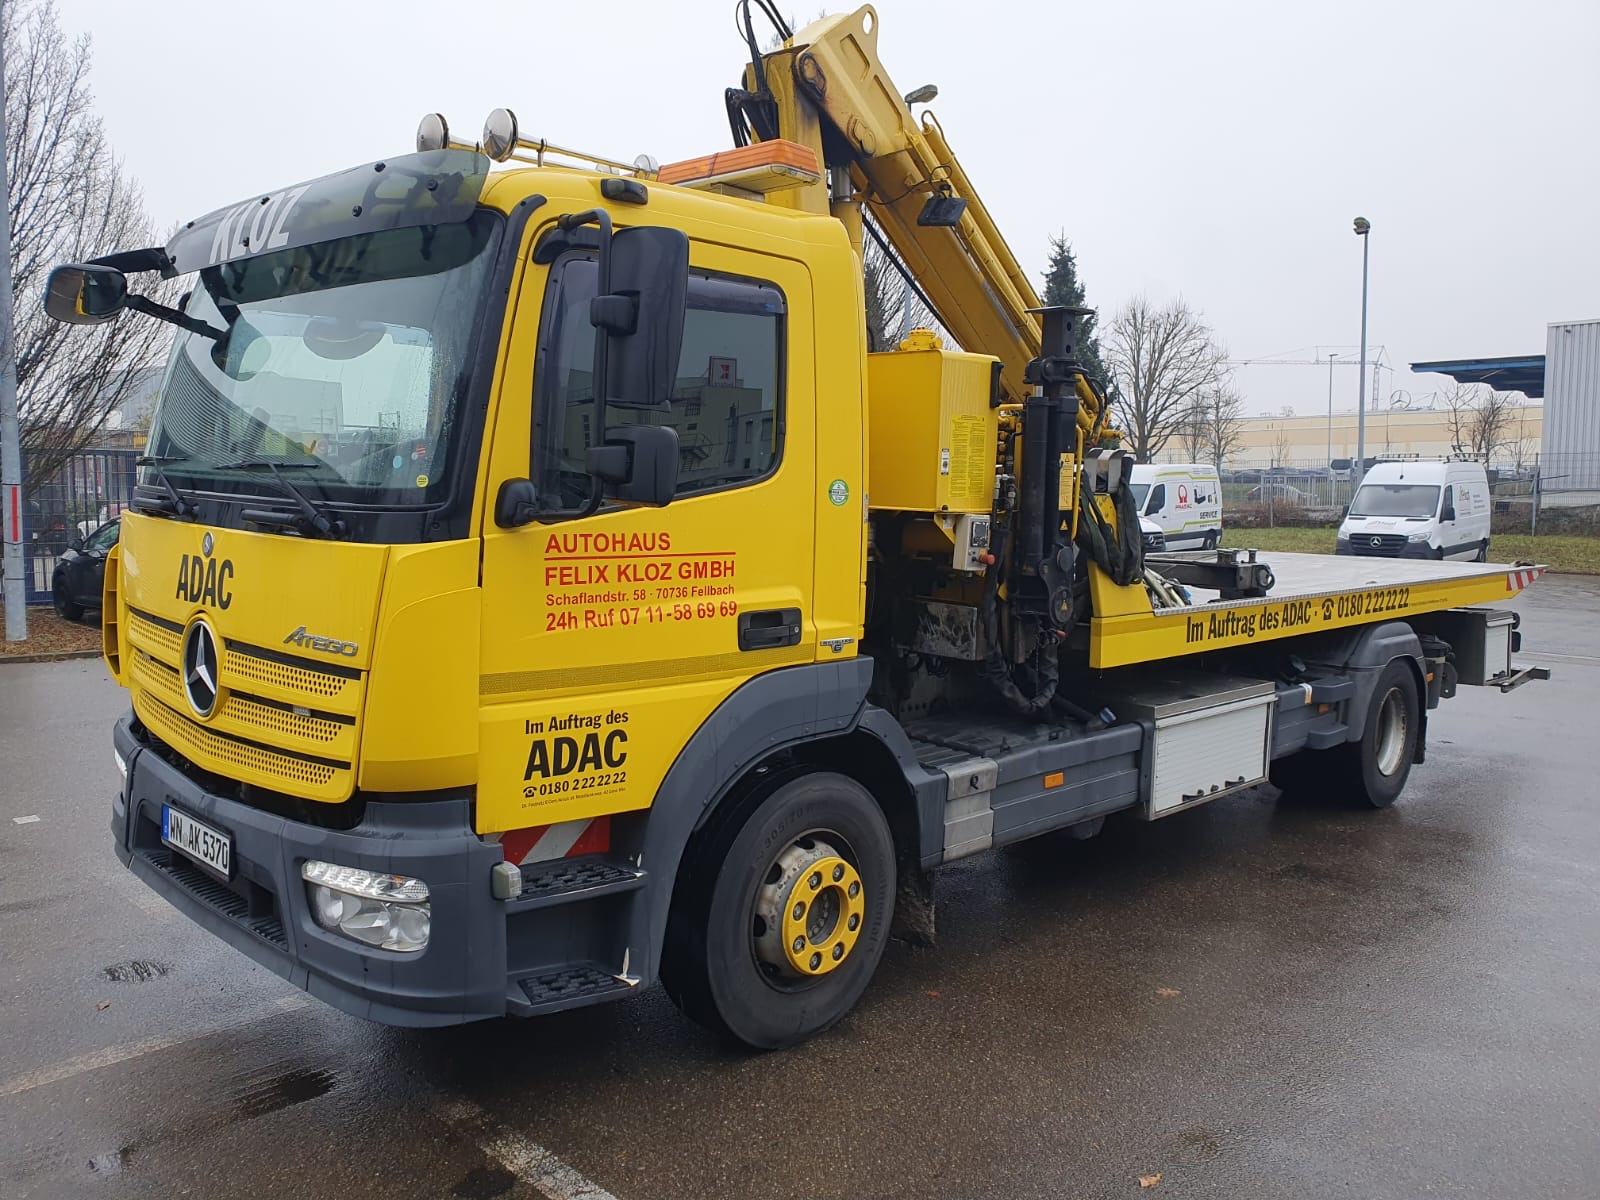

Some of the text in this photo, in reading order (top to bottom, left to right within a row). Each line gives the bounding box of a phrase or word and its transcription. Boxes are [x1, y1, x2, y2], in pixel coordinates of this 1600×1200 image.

[208, 183, 313, 264] KLOZ
[1199, 511, 1218, 519] SERVICE
[545, 532, 671, 553] AUTOHAUS
[175, 554, 234, 610] ADAC
[545, 560, 735, 587] FELIX KLOZ GMBH
[546, 584, 735, 607] Schaflandstr. 58 70736 Fellbach
[546, 612, 578, 632] 24h
[584, 608, 615, 629] Ruf
[620, 608, 640, 626] 07
[697, 602, 716, 619] 69
[720, 600, 737, 617] 69
[1186, 616, 1204, 643] Im
[1207, 611, 1256, 638] Auftrag
[1259, 606, 1279, 631] des
[1281, 600, 1312, 628] ADAC
[1337, 593, 1364, 618] 0180
[525, 709, 629, 735] Im Auftrag des
[523, 729, 628, 780] ADAC
[539, 780, 570, 796] 0180
[170, 813, 228, 869] WN AK 5370
